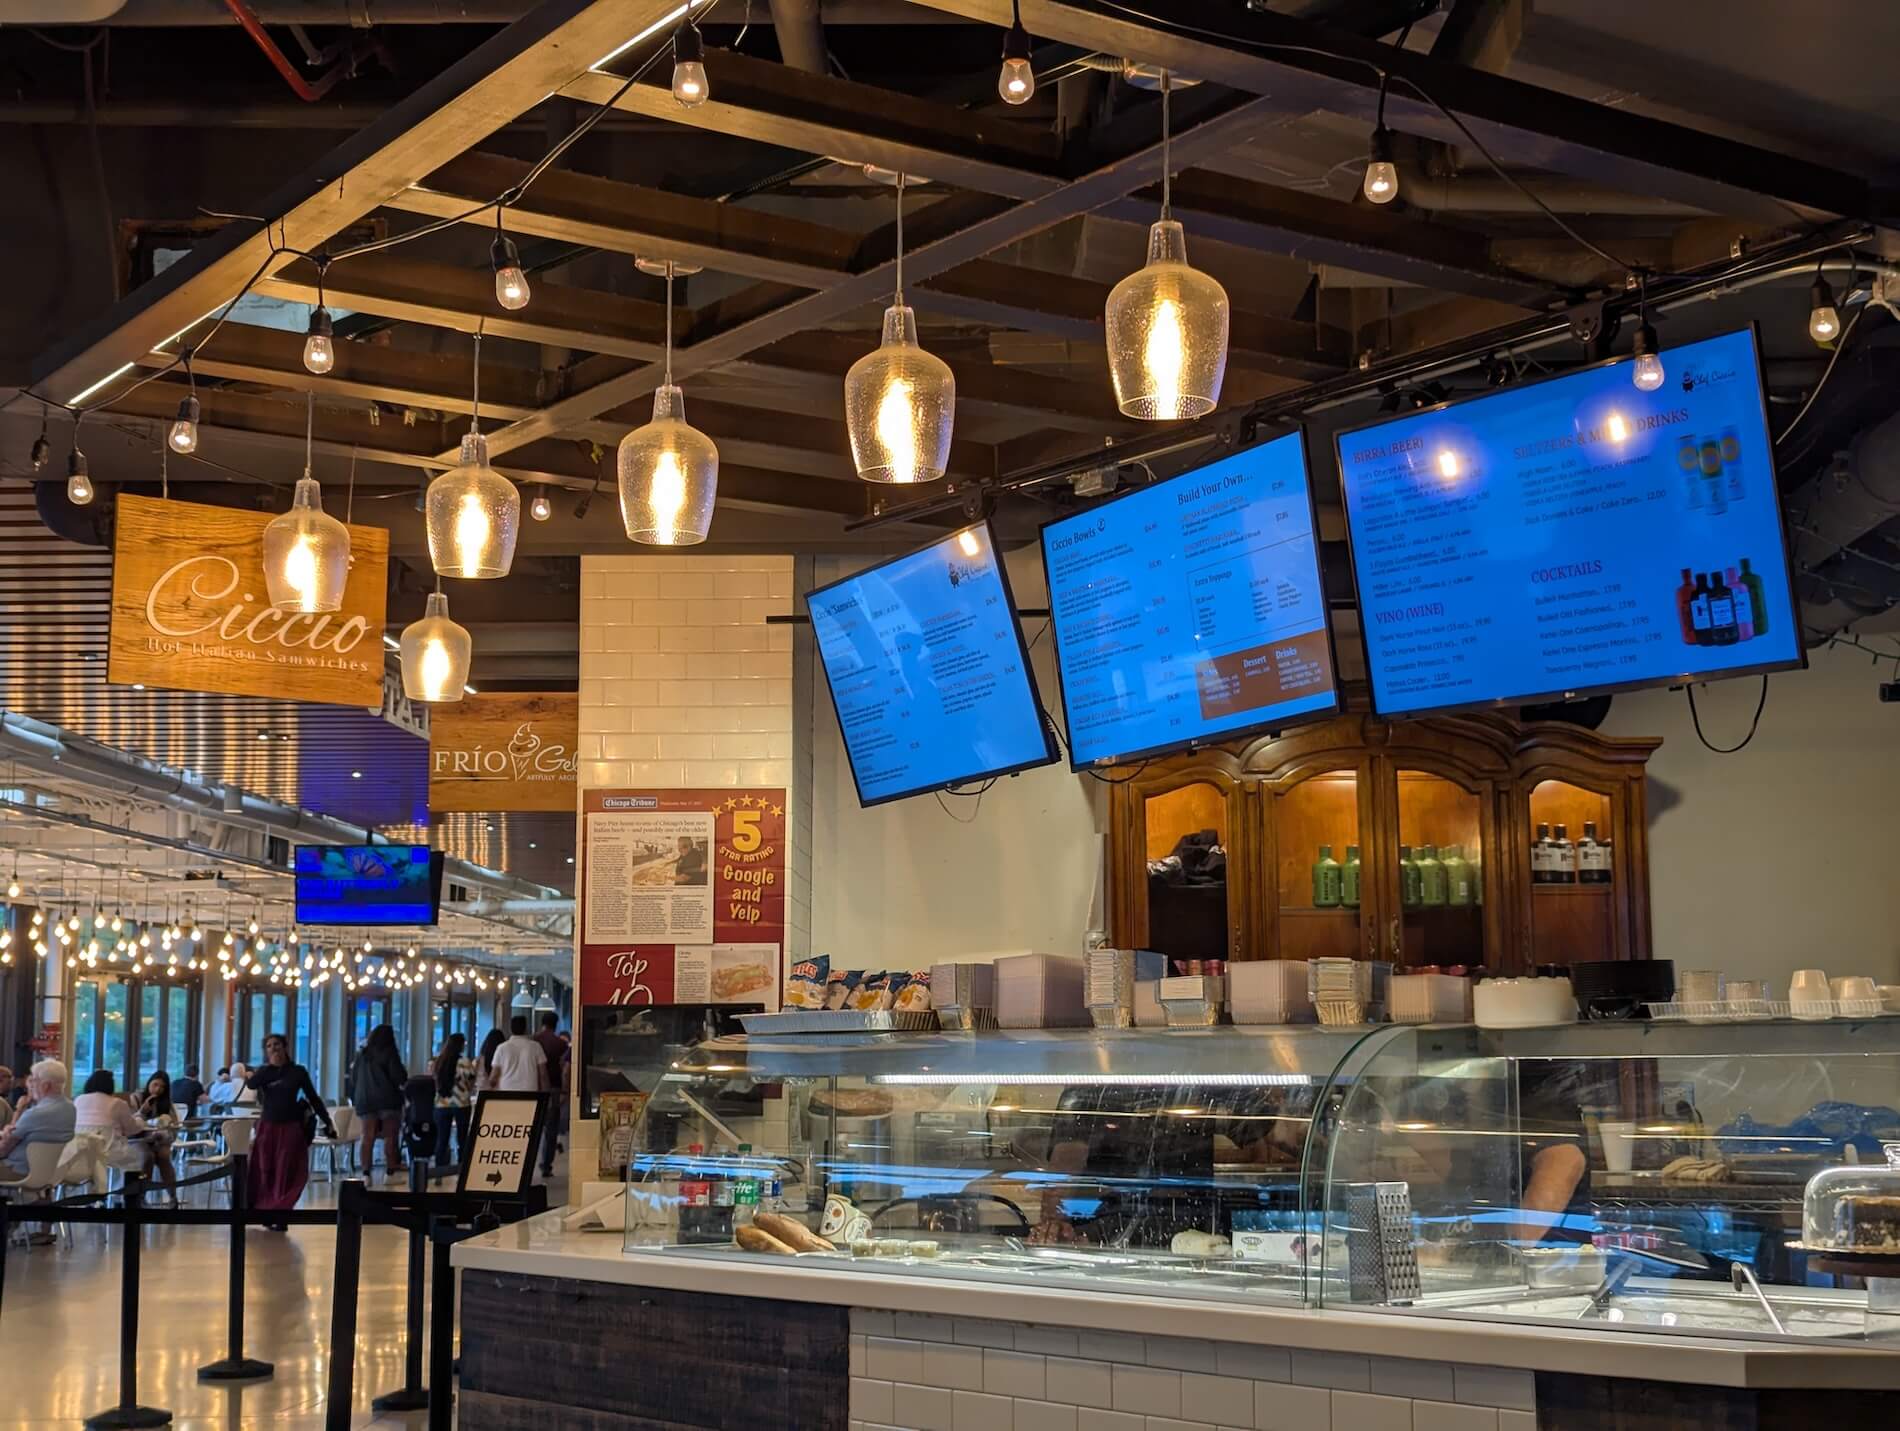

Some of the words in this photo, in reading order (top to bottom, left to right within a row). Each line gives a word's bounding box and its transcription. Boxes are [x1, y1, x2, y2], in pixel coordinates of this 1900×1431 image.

[1636, 408, 1689, 432] DRINKS
[1353, 445, 1386, 464] BIRRA
[1388, 437, 1424, 457] (BEER)
[1177, 486, 1200, 505] Build
[1201, 480, 1221, 497] Your
[1051, 536, 1073, 552] Ciccio
[1073, 526, 1096, 545] Bowls
[1531, 559, 1602, 584] COCKTAILS
[145, 555, 372, 654] Ciccio
[1375, 608, 1404, 624] VINO
[1405, 601, 1445, 622] (WINE)
[147, 636, 182, 653] Hot
[192, 641, 256, 661] Italian
[266, 650, 369, 673] Samwiches
[1243, 655, 1267, 669] Dessert
[1275, 647, 1297, 660] Drinks
[433, 745, 507, 773] FRÍO
[526, 774, 556, 782] ARTFULLY
[605, 798, 630, 808] Chicago
[630, 798, 656, 807] Tribune
[732, 811, 762, 852] 5
[719, 846, 741, 861] STAR
[743, 845, 774, 863] RATING
[723, 864, 775, 885] Google
[731, 887, 762, 903] and
[729, 903, 760, 924] Yelp
[607, 950, 648, 988] Top
[607, 984, 654, 1005] 10
[477, 1124, 533, 1139] ORDER
[478, 1149, 522, 1165] HERE
